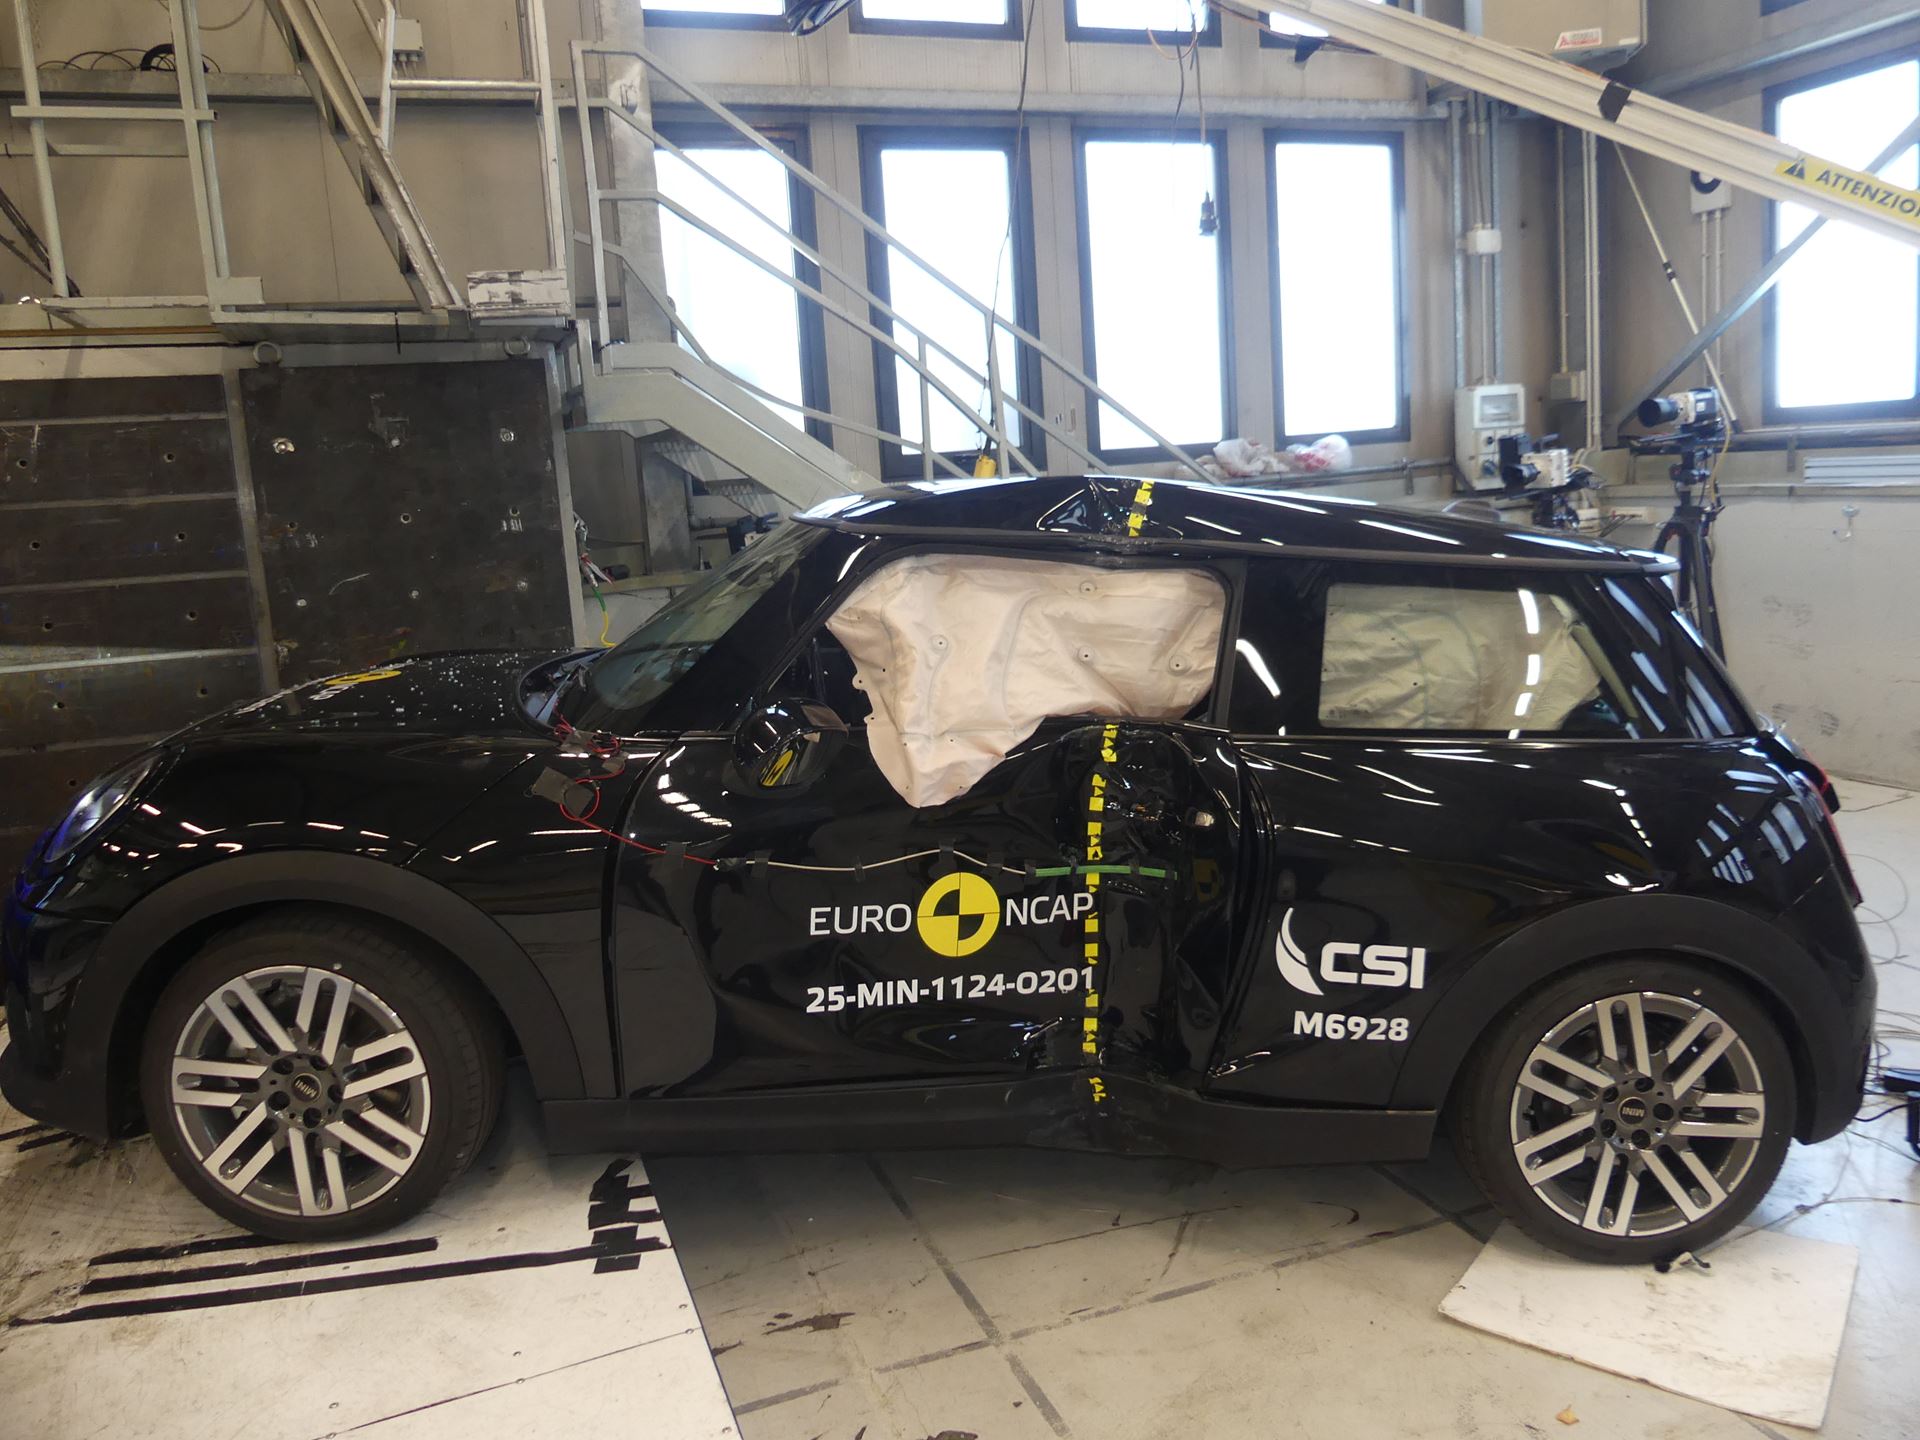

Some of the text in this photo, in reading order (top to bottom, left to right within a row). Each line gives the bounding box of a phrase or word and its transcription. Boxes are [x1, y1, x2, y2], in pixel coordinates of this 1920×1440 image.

[1816, 170, 1920, 218] ATTENZIO
[809, 892, 1094, 936] EURO NCAP
[1320, 941, 1426, 989] CSI
[806, 966, 1092, 1013] 25-MIN-1124-0201
[1293, 1010, 1410, 1042] M6928
[294, 1079, 318, 1098] MINI
